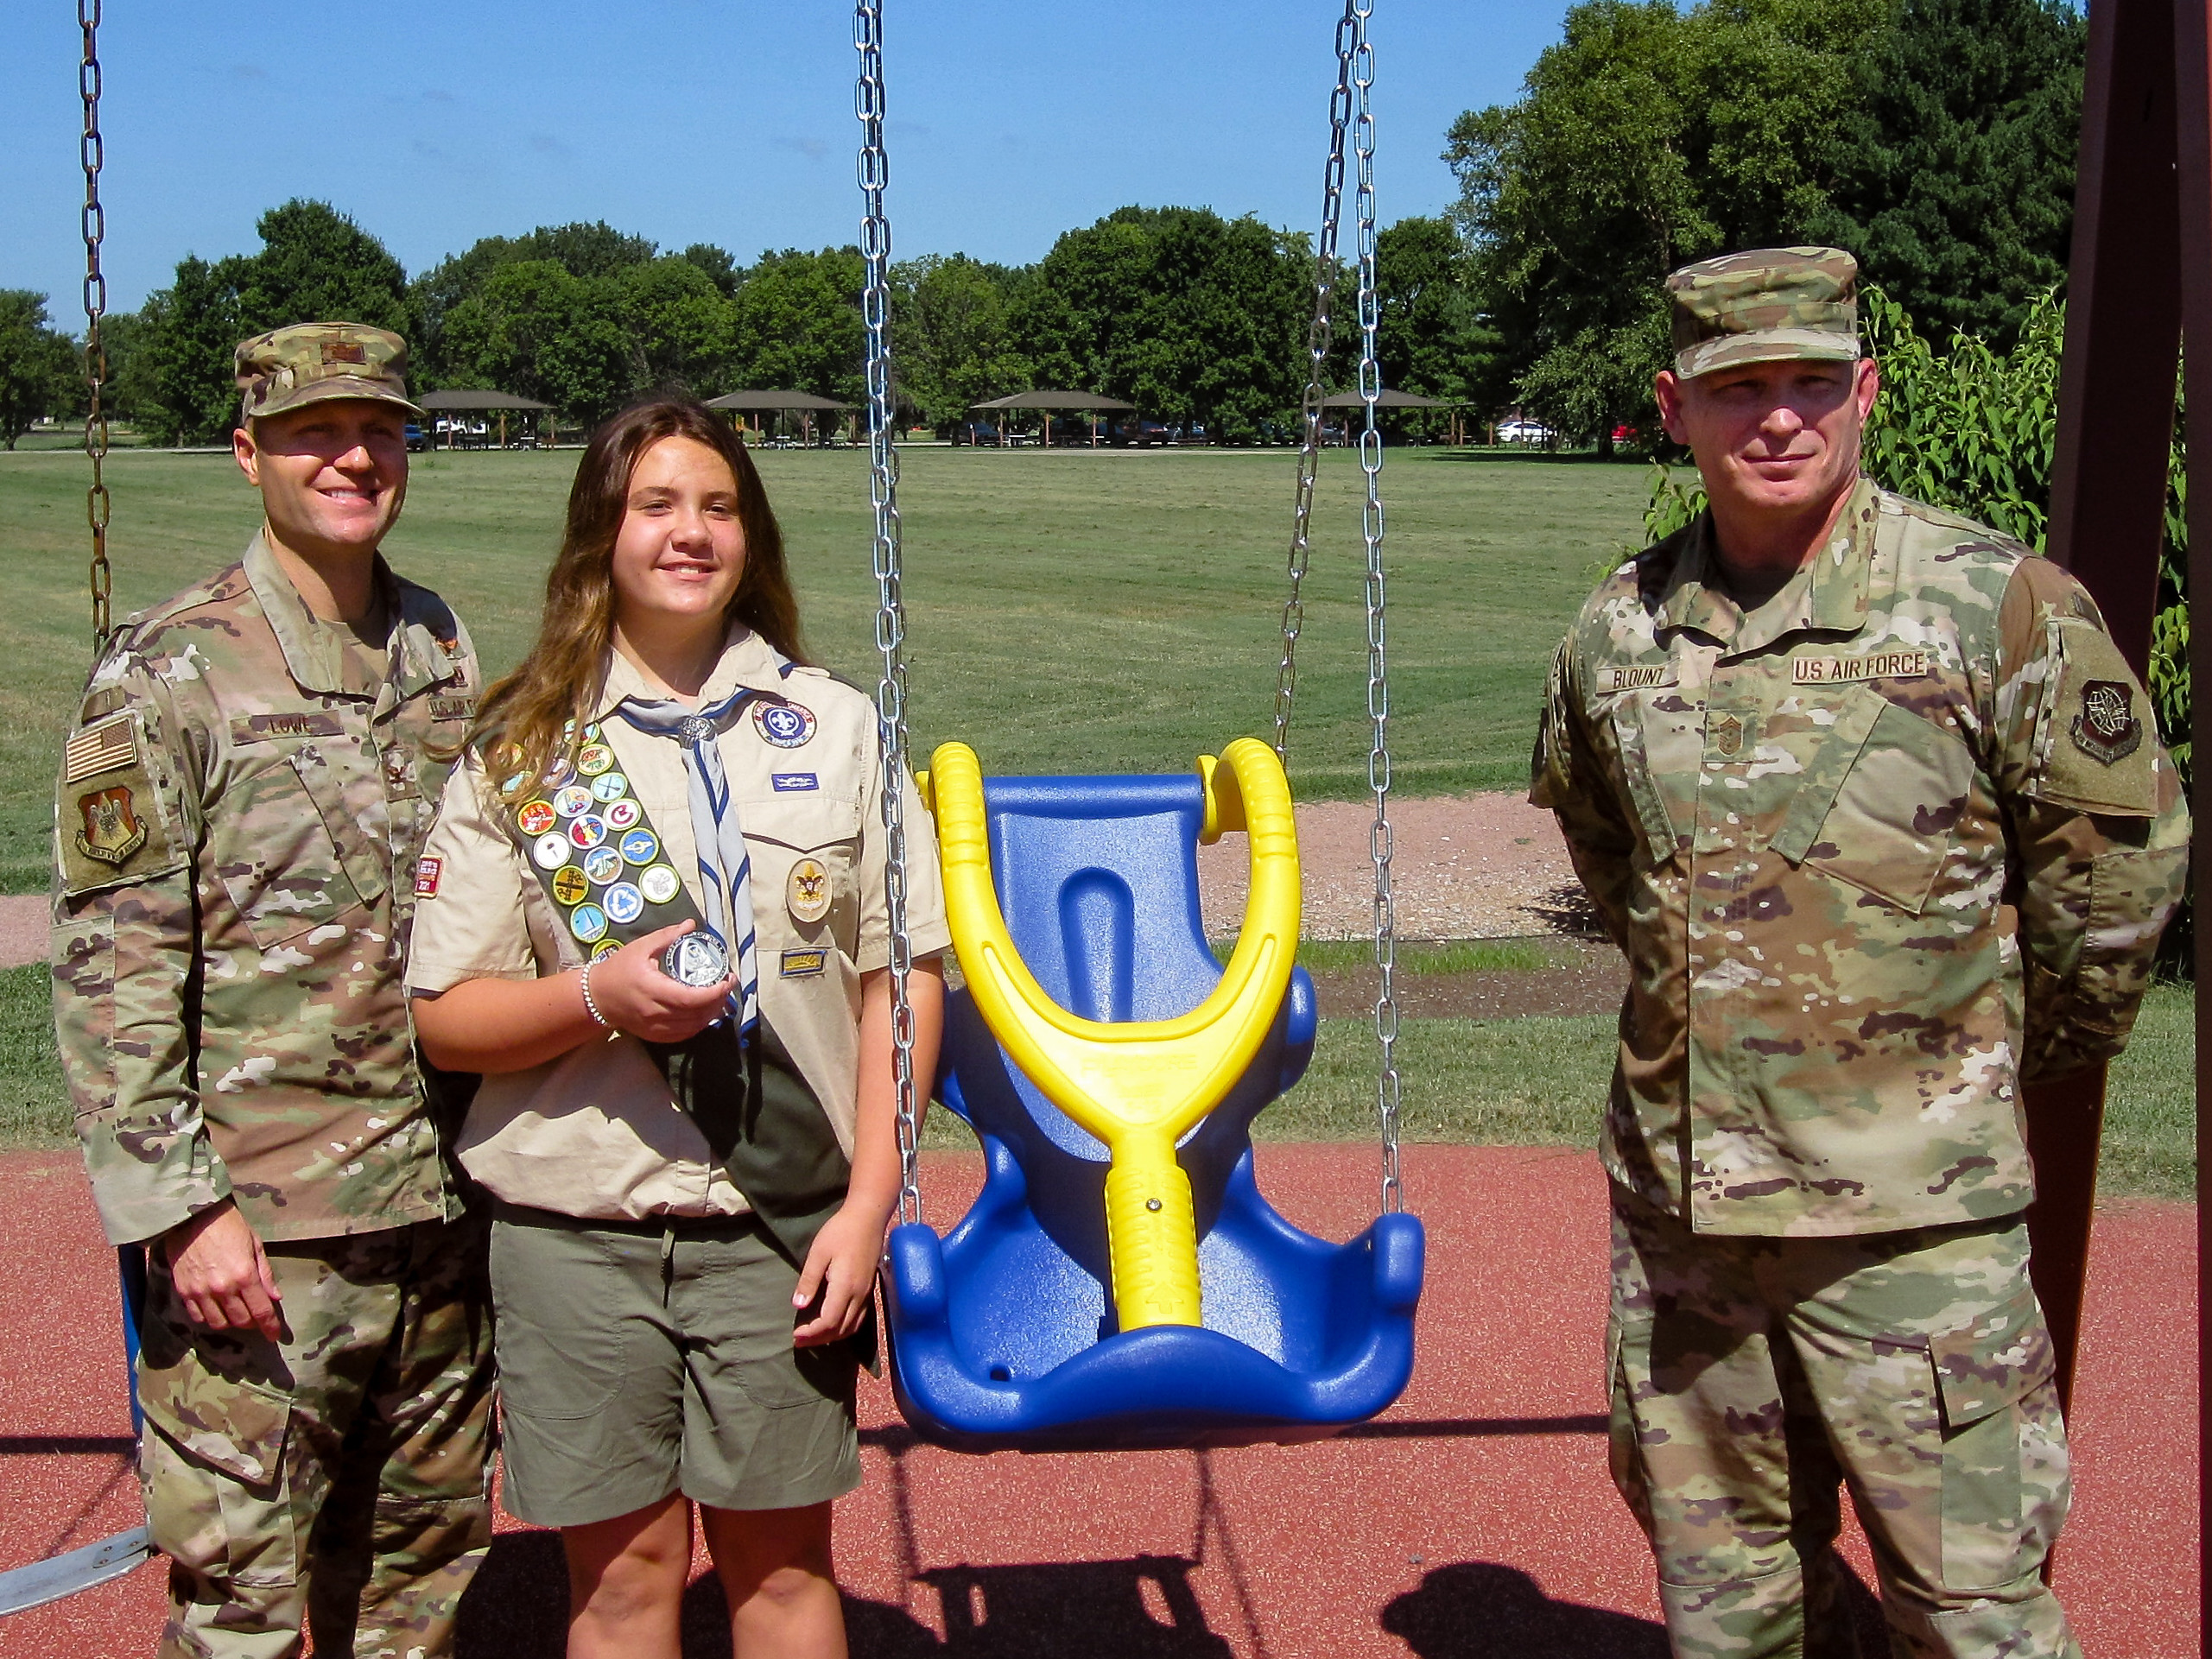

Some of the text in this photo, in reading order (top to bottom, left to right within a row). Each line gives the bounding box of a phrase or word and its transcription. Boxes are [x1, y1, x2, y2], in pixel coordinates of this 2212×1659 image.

[1831, 658, 1861, 680] AIR
[1866, 651, 1924, 677] FORCE
[1613, 667, 1665, 690] BLOUNT
[269, 715, 313, 735] LOWE
